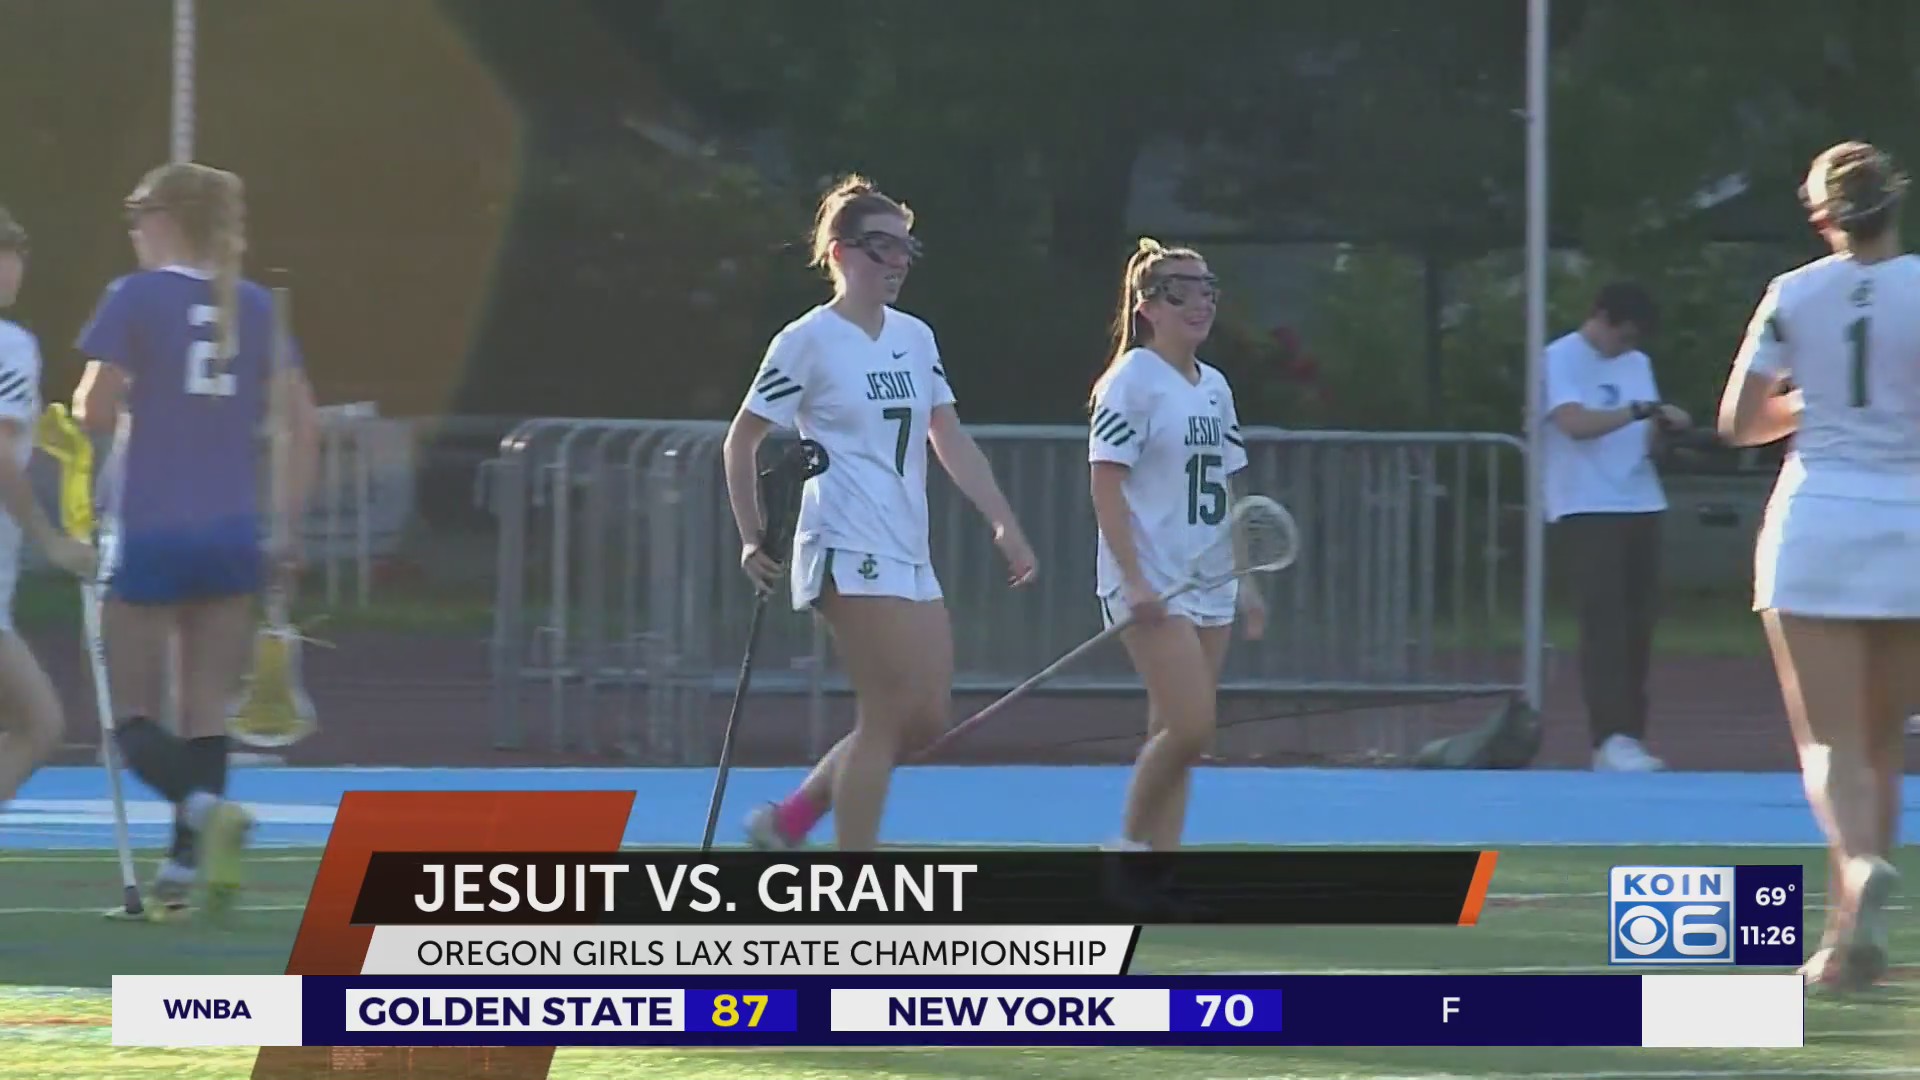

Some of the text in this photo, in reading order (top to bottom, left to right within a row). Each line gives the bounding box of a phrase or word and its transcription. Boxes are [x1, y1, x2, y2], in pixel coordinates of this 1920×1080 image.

[185, 303, 238, 396] 2
[866, 371, 917, 400] JESUIT
[1843, 316, 1871, 408] 1
[882, 407, 912, 477] 7
[1185, 453, 1226, 525] 15
